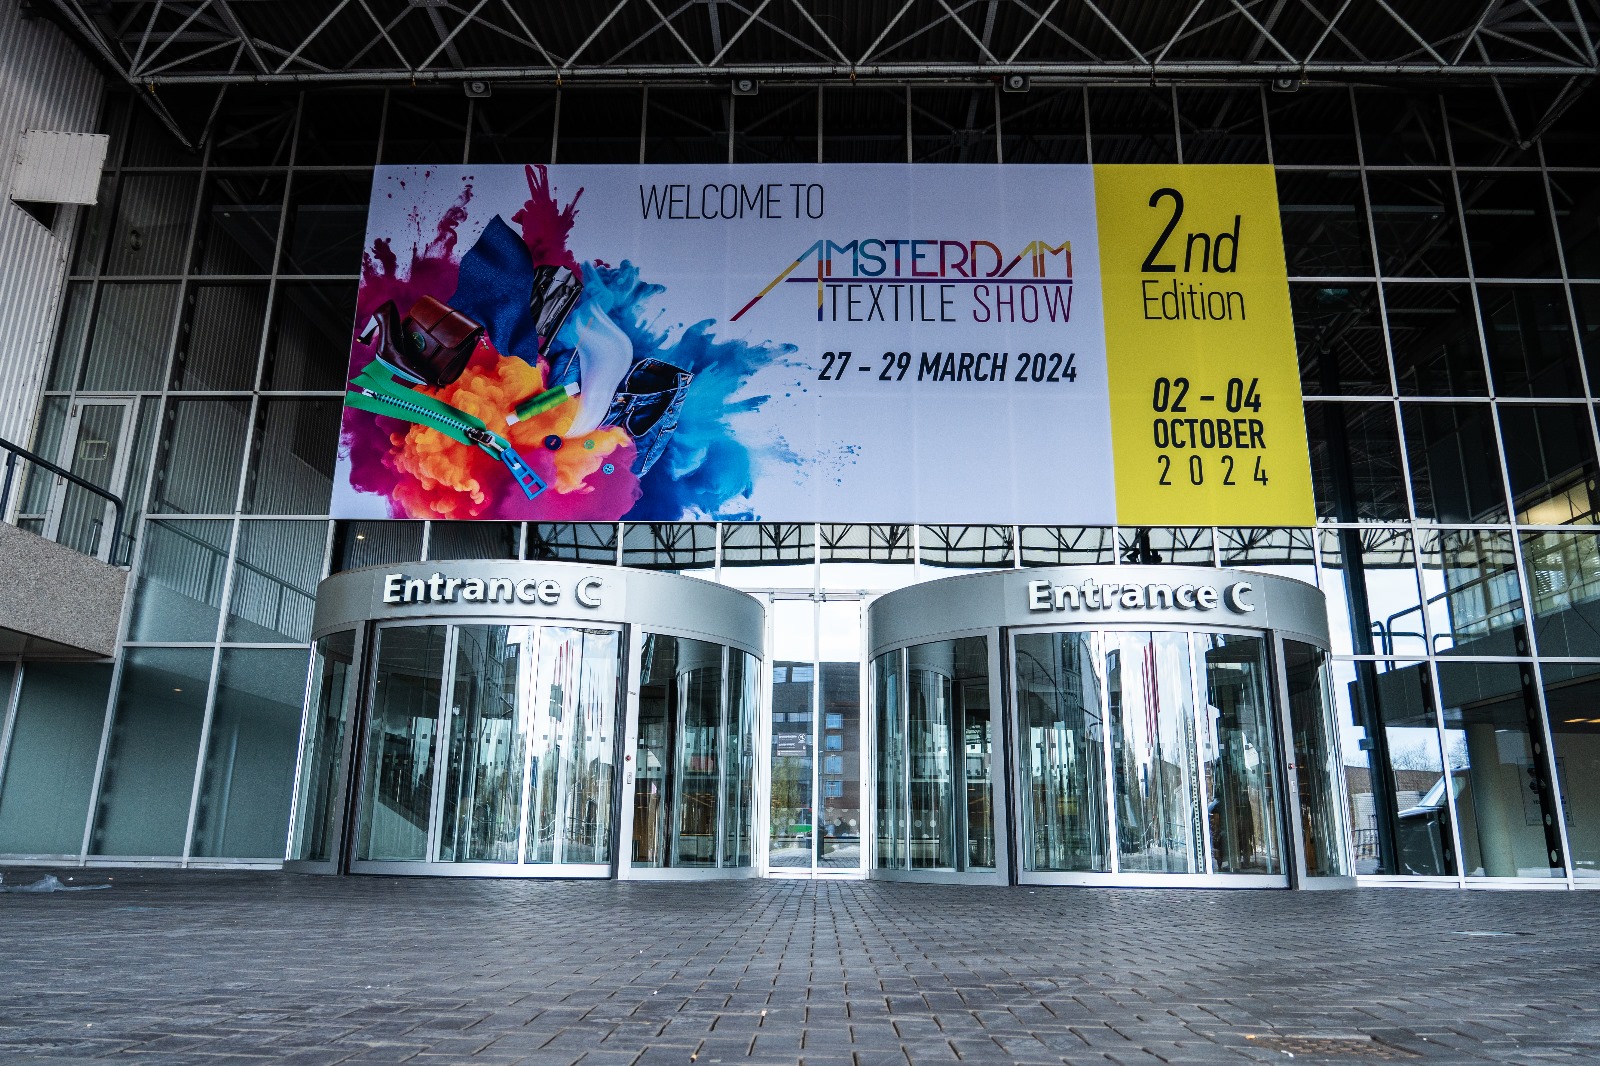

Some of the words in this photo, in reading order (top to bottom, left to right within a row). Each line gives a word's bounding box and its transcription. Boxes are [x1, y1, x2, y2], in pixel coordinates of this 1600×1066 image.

[639, 183, 783, 220] WELCOME
[789, 183, 824, 219] TO
[1141, 187, 1242, 274] 2nd
[729, 238, 1074, 322] AMSTERDAM
[825, 284, 957, 323] TEXTILE
[972, 284, 1074, 324] SHOW
[1141, 278, 1246, 321] Edition
[818, 351, 852, 382] 27
[879, 351, 912, 383] 29
[917, 352, 1009, 383] MARCH
[1014, 352, 1078, 384] 2024
[1152, 376, 1190, 413] 02
[1226, 377, 1262, 413] 04
[1153, 418, 1267, 449] OCTOBER
[383, 572, 561, 605] Entrance
[575, 575, 604, 608] C
[1028, 577, 1219, 612] Entrance
[1223, 581, 1256, 614] C
